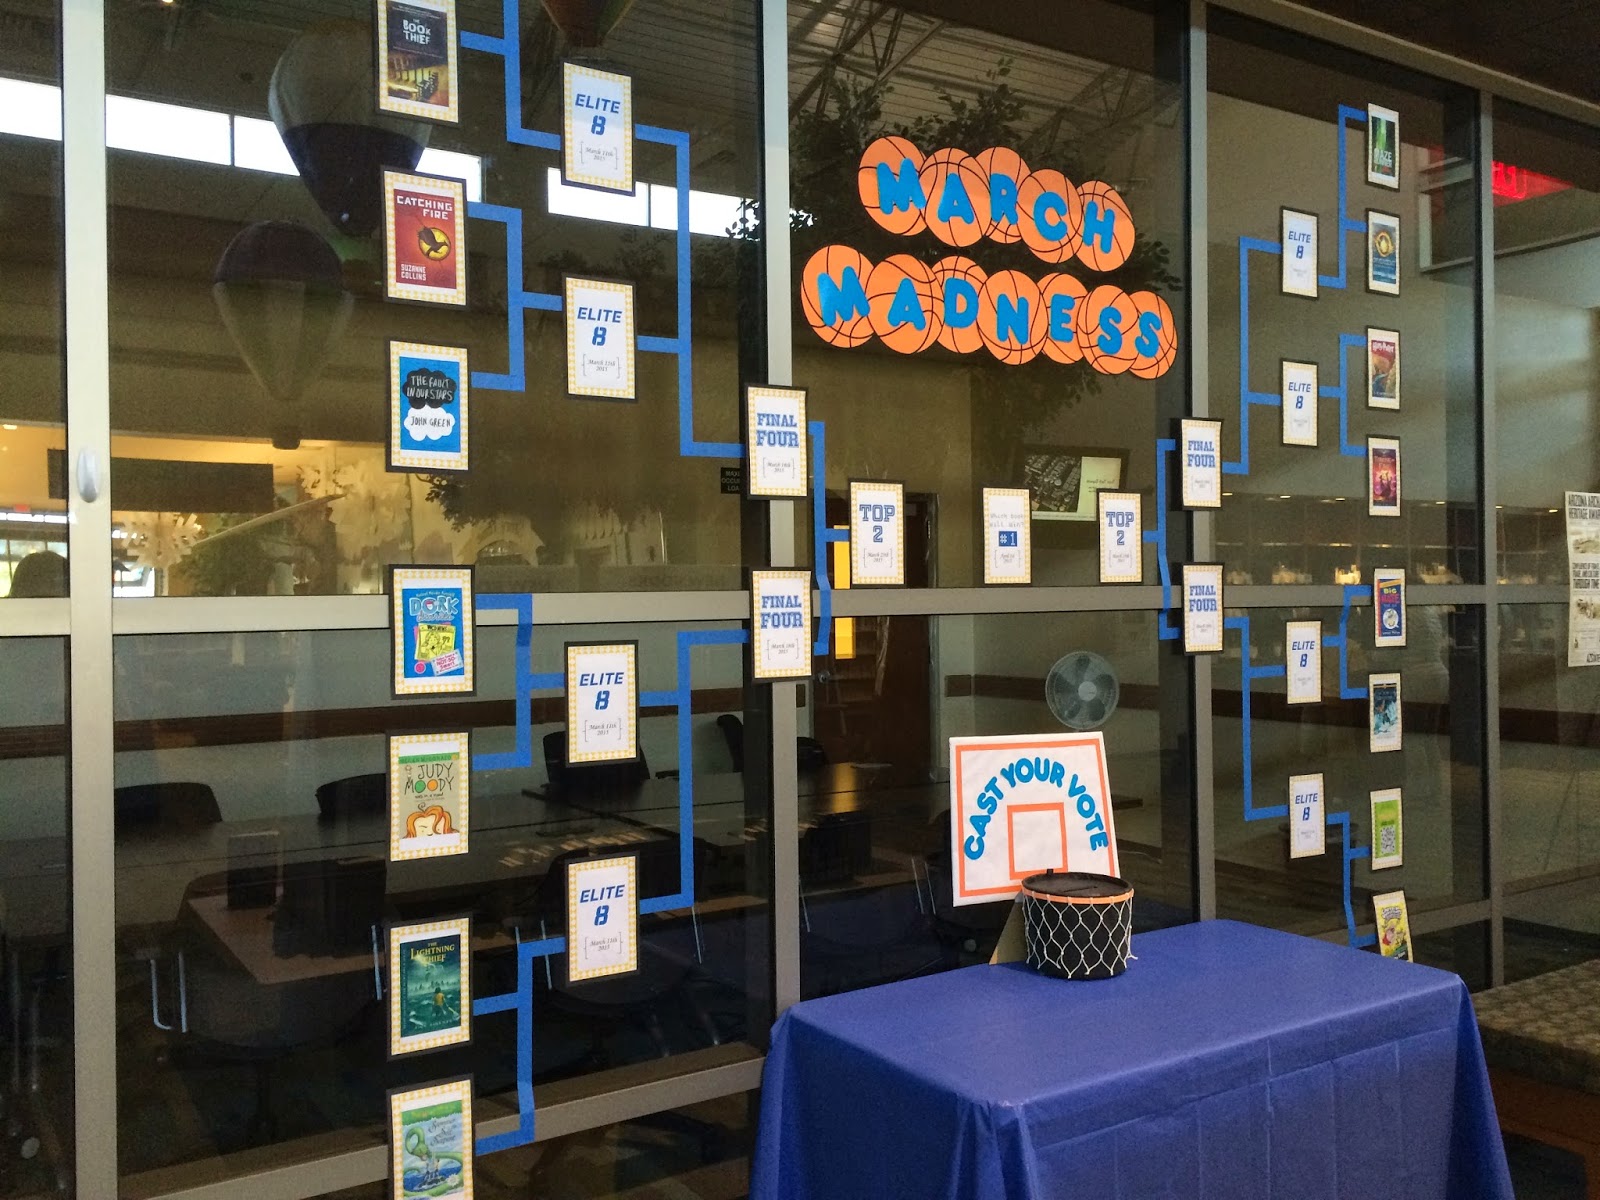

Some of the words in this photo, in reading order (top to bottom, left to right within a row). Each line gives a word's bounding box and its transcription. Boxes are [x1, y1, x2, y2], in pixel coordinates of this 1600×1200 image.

[402, 19, 431, 36] BOOK
[402, 30, 430, 45] THIEF
[575, 93, 621, 114] ELITE
[591, 115, 606, 135] 8
[397, 195, 453, 212] CATCHING
[877, 158, 1115, 254] MARCH
[423, 209, 449, 220] FIRE
[1288, 231, 1311, 243] ELITE
[1296, 245, 1304, 259] 8
[401, 264, 426, 273] SUZANNE
[401, 271, 427, 281] COLLINS
[577, 307, 622, 323] ELITE
[817, 265, 1162, 358] MADNESS
[592, 326, 607, 346] 8
[411, 375, 427, 386] THE
[429, 377, 450, 389] FAULT
[1288, 382, 1311, 393] ELITE
[407, 387, 416, 397] IN
[416, 389, 429, 399] OUR
[430, 389, 453, 401] STARS
[1295, 395, 1304, 409] 8
[411, 416, 427, 426] JOHN
[430, 418, 451, 427] GREEN
[756, 413, 798, 427] FINAL
[756, 430, 800, 448] FOUR
[1188, 440, 1215, 451] FINAL
[1187, 454, 1216, 468] FOUR
[859, 504, 895, 522] TOP
[1106, 511, 1135, 527] TOP
[872, 525, 884, 543] 2
[1116, 530, 1125, 545] 2
[1189, 585, 1216, 596] FINAL
[409, 595, 459, 616] DORK
[761, 595, 802, 609] FINAL
[1188, 598, 1217, 613] FOUR
[760, 612, 803, 629] FOUR
[1292, 640, 1315, 650] ELITE
[1299, 653, 1308, 668] 8
[579, 672, 624, 687] ELITE
[594, 690, 610, 710] 8
[417, 762, 454, 780] JUDY
[404, 776, 455, 795] MOODY
[1295, 793, 1319, 804] ELITE
[964, 776, 1004, 860] CAST
[1000, 757, 1065, 788] YOUR
[1068, 773, 1109, 851] VOTE
[1302, 806, 1311, 821] 8
[580, 884, 625, 903] ELITE
[594, 905, 609, 926] 8
[410, 944, 455, 960] LIGHTNING
